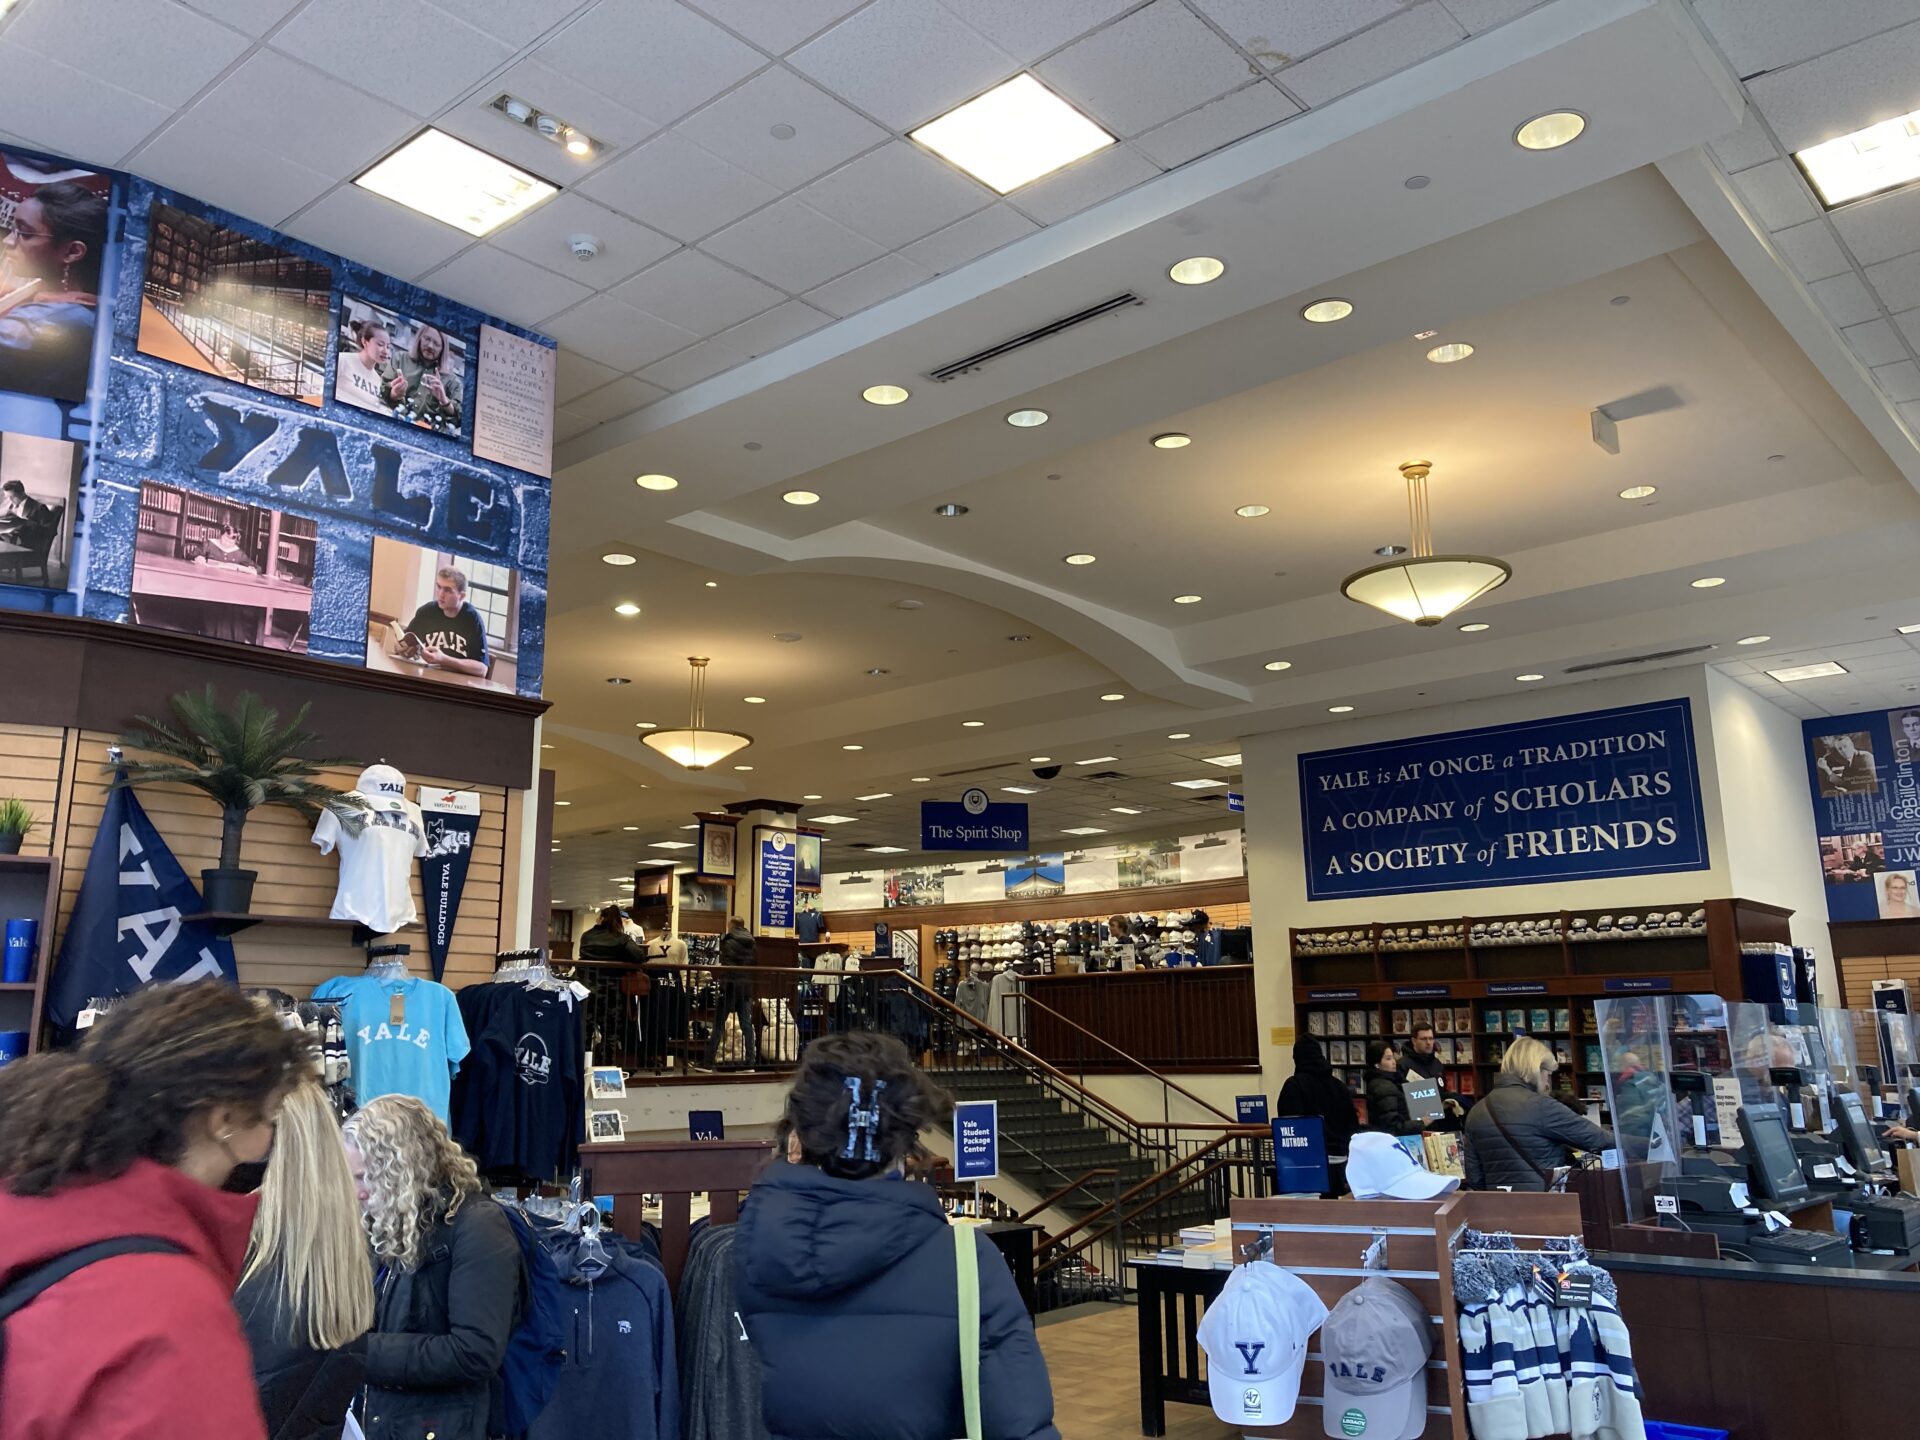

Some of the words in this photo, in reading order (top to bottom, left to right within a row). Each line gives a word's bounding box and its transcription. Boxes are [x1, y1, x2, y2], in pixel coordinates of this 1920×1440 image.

[483, 350, 546, 378] HISTORY
[200, 395, 496, 546] YALE
[1319, 769, 1370, 791] YALE
[1377, 768, 1391, 784] is
[1396, 763, 1422, 782] AT
[1428, 753, 1496, 777] ONCE
[1503, 755, 1513, 768] a
[1519, 730, 1666, 766] TRADITION
[1895, 739, 1918, 808] BillClinton
[1322, 816, 1337, 832] A
[1342, 801, 1456, 830] COMPANY
[1463, 796, 1486, 821] of
[1494, 771, 1672, 814] SCHOLARS
[929, 825, 954, 838] The
[956, 825, 988, 841] Spirit
[991, 825, 1022, 842] Shop
[1326, 855, 1344, 876] A
[1350, 842, 1470, 873] SOCIETY
[1476, 842, 1499, 867] of
[1505, 817, 1677, 860] FRIENDS
[441, 863, 450, 889] YALE
[437, 891, 448, 946] BULLDOGS
[8, 937, 29, 948] Yale
[659, 945, 671, 956] Y
[357, 1022, 431, 1049] YALE
[515, 1047, 552, 1074] YALE
[1410, 1088, 1437, 1099] YALE
[963, 1120, 978, 1128] Yale
[1280, 1126, 1295, 1136] YALE
[963, 1137, 991, 1145] Package
[1281, 1137, 1308, 1147] AUTHORS
[1235, 1341, 1265, 1375] Y
[1329, 1362, 1386, 1383] YALE
[1342, 1418, 1366, 1426] LEGACY
